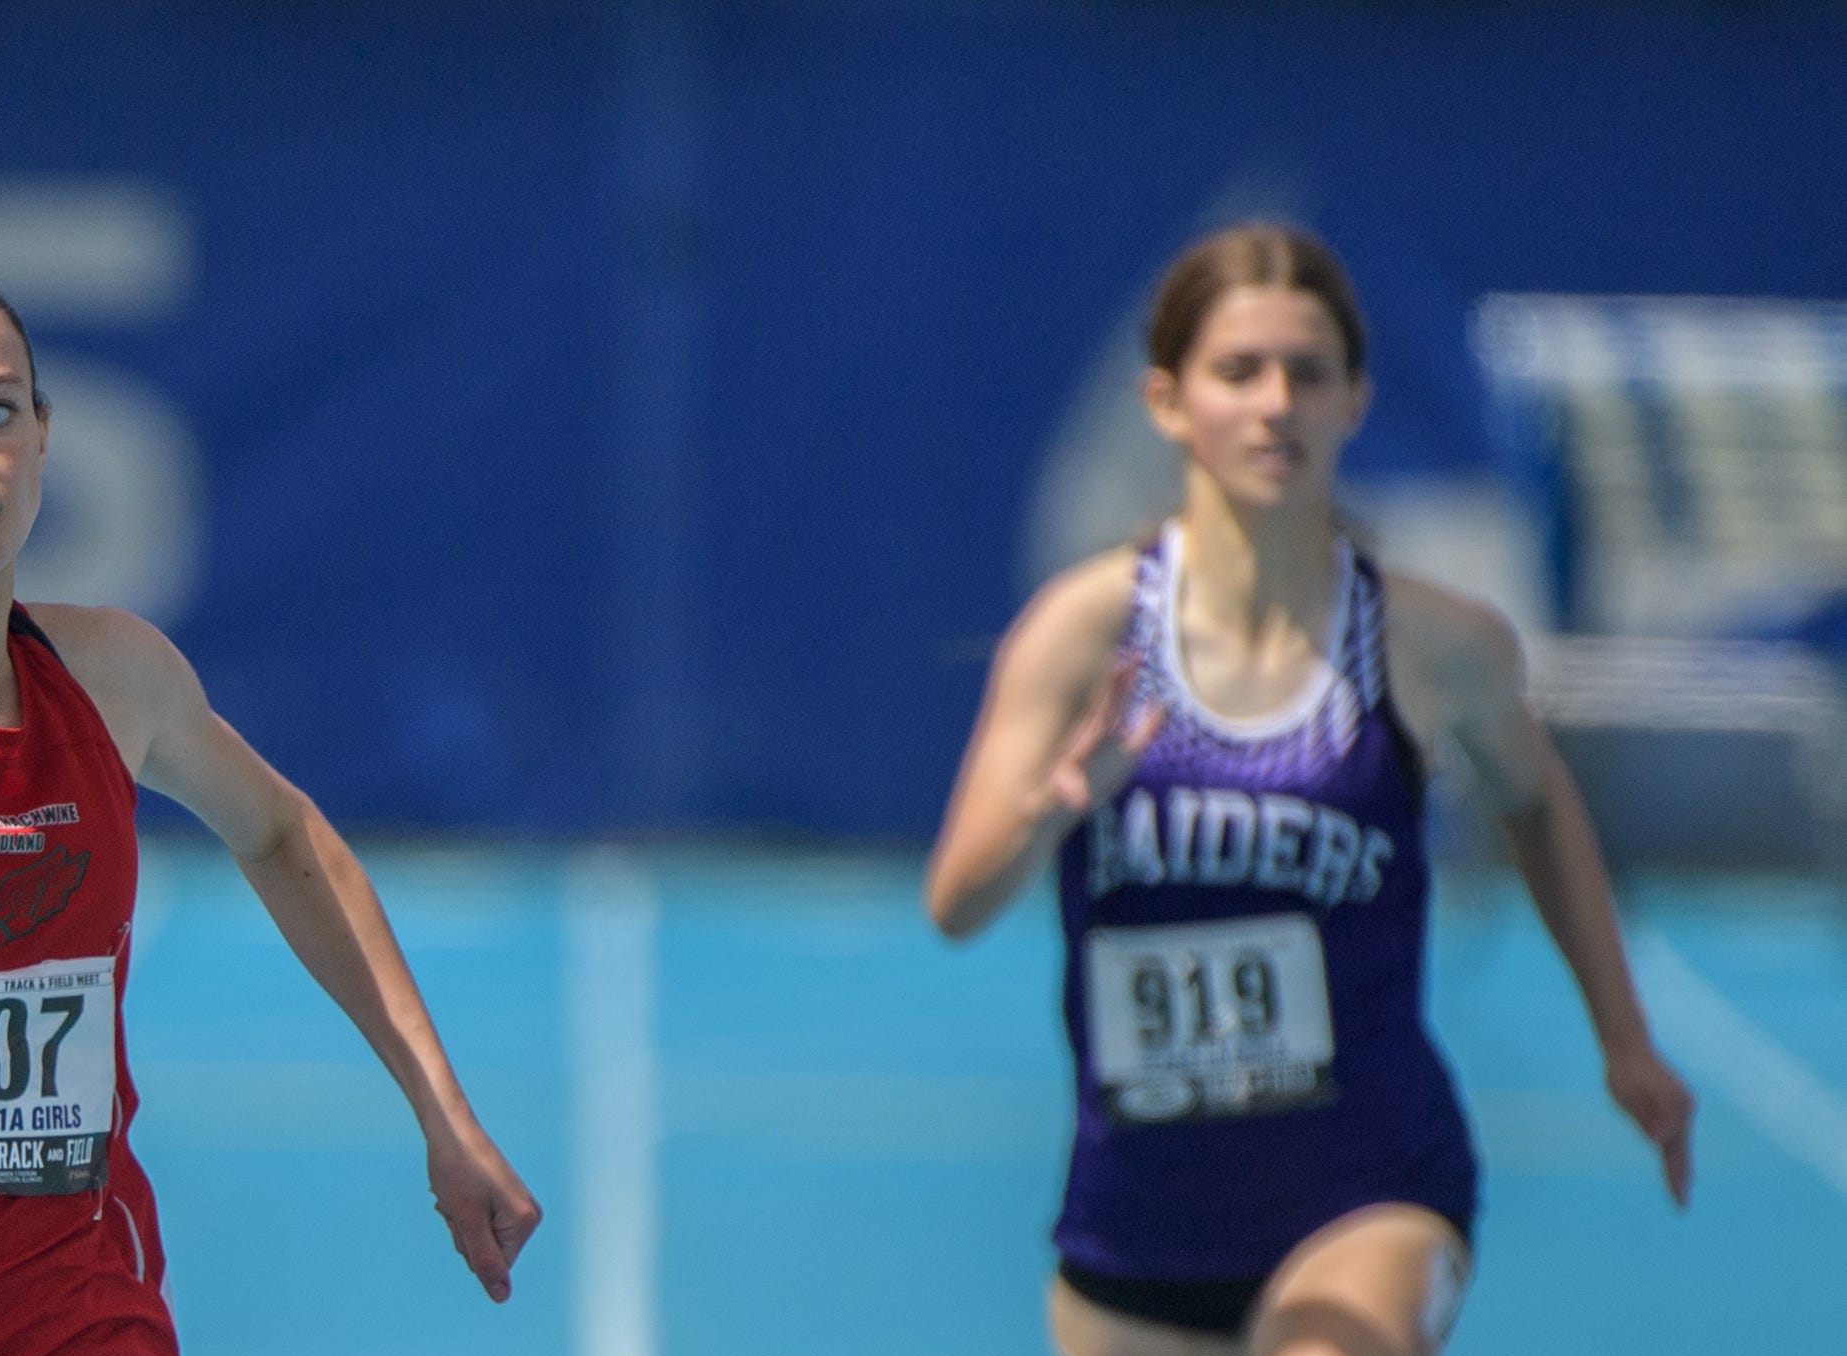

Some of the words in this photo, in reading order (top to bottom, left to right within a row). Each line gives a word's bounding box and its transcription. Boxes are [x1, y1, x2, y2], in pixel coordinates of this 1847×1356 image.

[4, 978, 34, 992] TRACK
[49, 975, 74, 988] FIELD
[77, 974, 100, 985] MEET
[1132, 947, 1283, 1052] 919
[32, 1104, 82, 1130] GIRLS
[47, 1148, 65, 1162] AND
[66, 1137, 94, 1167] FIELD
